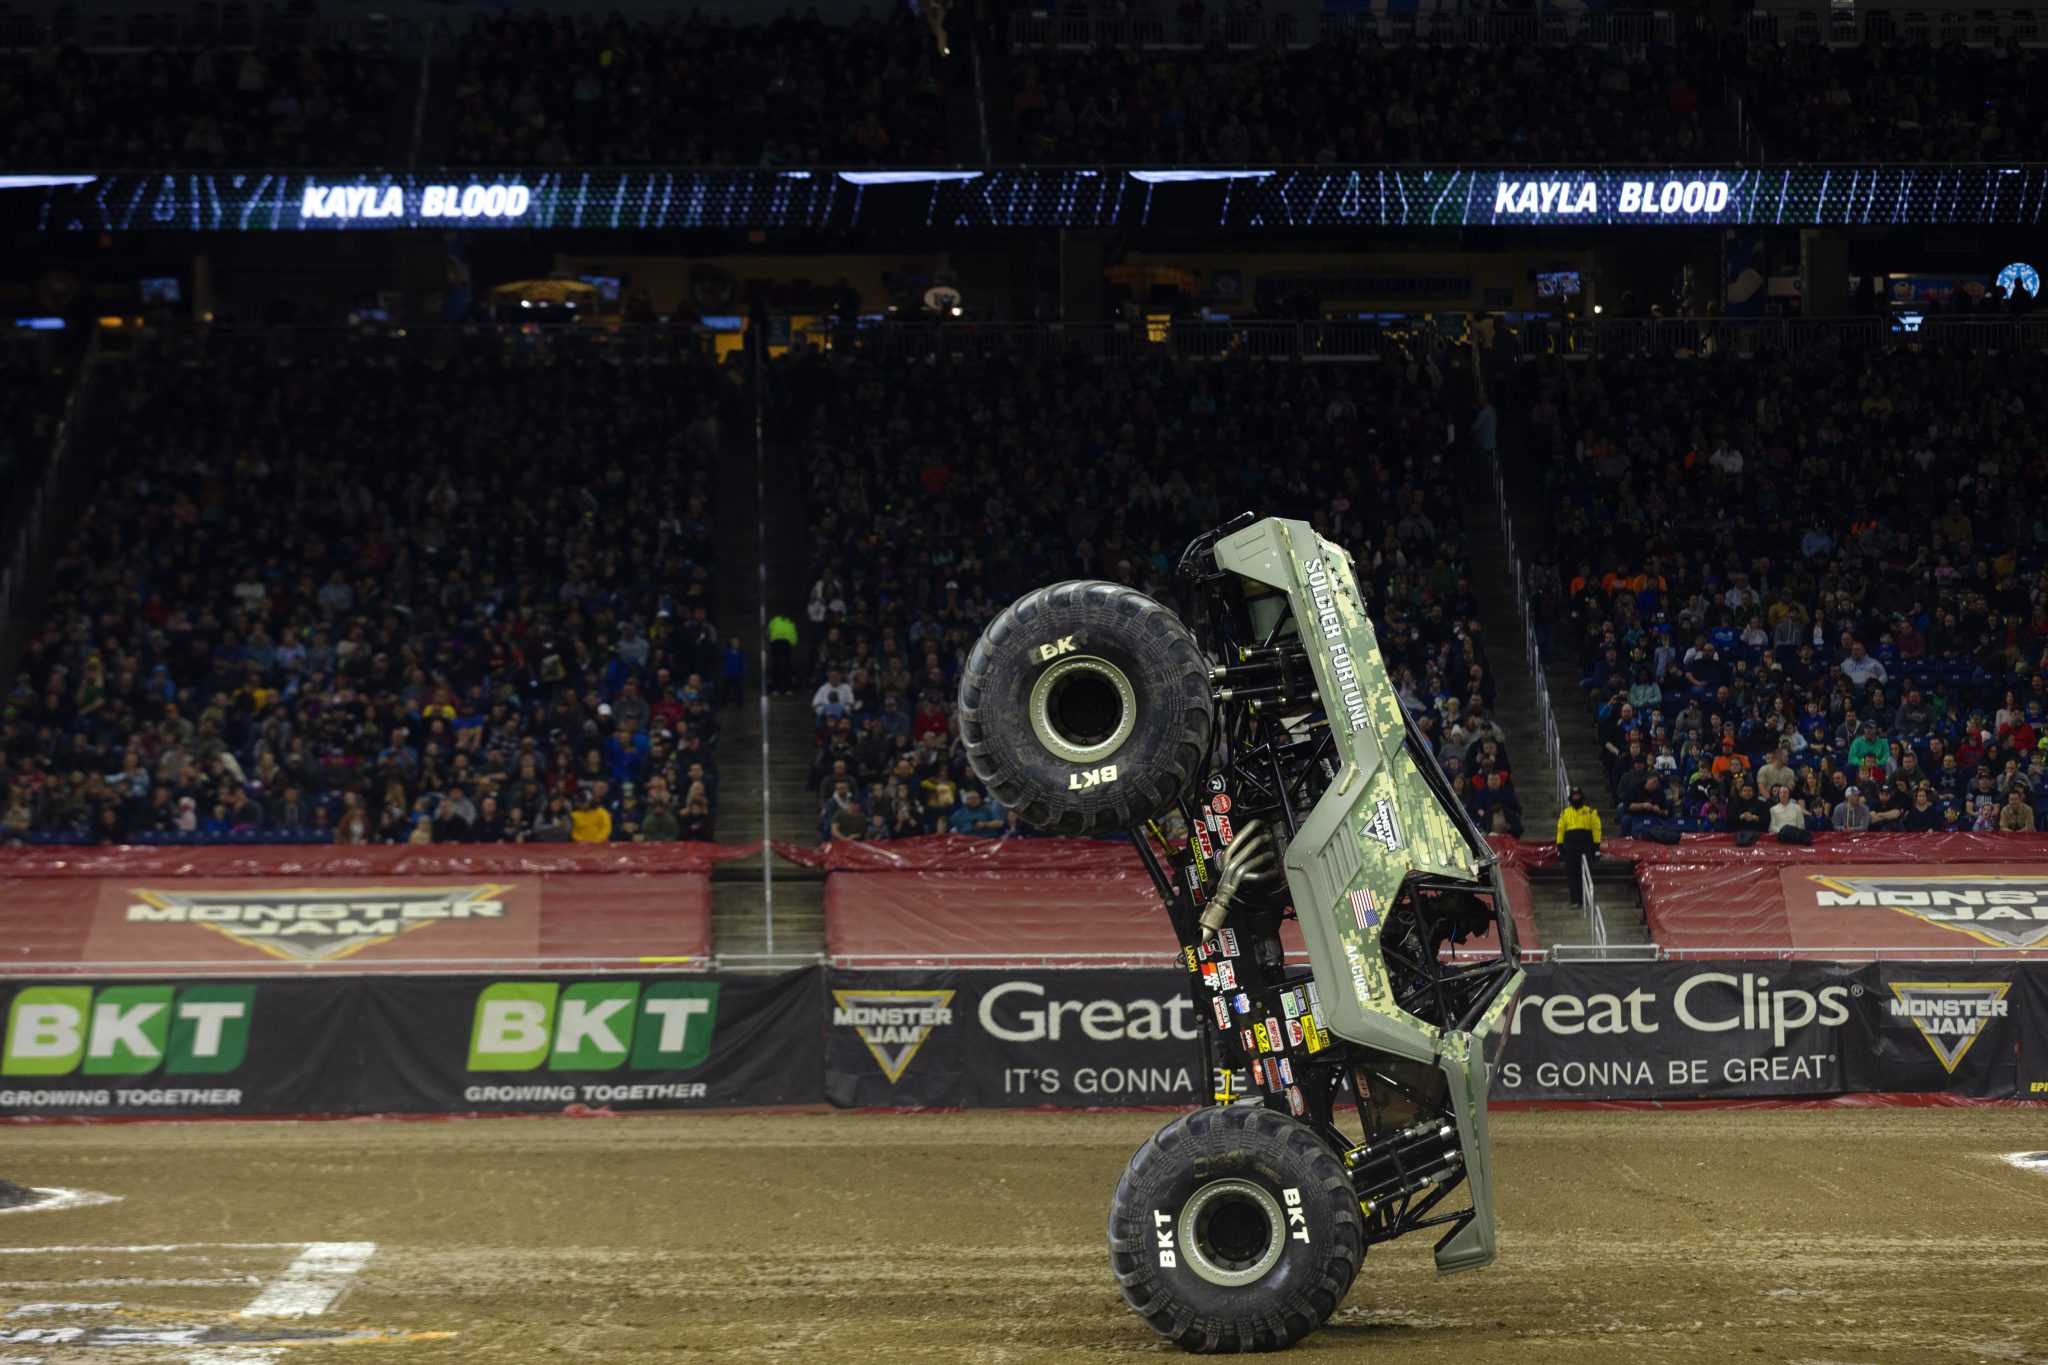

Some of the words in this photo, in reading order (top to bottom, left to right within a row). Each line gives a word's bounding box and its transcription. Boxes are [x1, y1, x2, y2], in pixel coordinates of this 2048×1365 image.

[301, 185, 403, 218] KAYLA
[420, 185, 530, 217] BLOOD
[1494, 182, 1597, 213] KAYLA
[1618, 181, 1729, 213] BLOOD
[1304, 558, 1342, 640] SOLDIER
[1328, 642, 1371, 733] FORTUNE
[1067, 765, 1118, 790] BKT
[1196, 820, 1212, 857] ARP
[1373, 817, 1387, 840] JAM
[1376, 800, 1397, 851] MONSTER
[126, 900, 504, 922] MONSTER
[1816, 890, 2048, 906] MONST
[232, 918, 398, 935] JAM
[1184, 945, 1199, 972] UNOH
[833, 1007, 953, 1025] MONSTER
[978, 981, 1198, 1042] Great
[1490, 986, 1659, 1035] reat
[1891, 999, 2008, 1017] MONSTER
[10, 1002, 246, 1057] BKT
[476, 998, 710, 1053] BKT
[867, 1026, 919, 1043] JAM
[1267, 1020, 1281, 1048] SIMPSON
[1925, 1017, 1976, 1034] JAM
[1004, 1068, 1060, 1093] IT'S
[1074, 1067, 1193, 1093] GONNA
[1536, 1061, 1654, 1087] GONNA
[1668, 1060, 1709, 1084] BE
[0, 1089, 111, 1106] GROWING
[115, 1088, 243, 1106] TOGETHER
[464, 1086, 576, 1102] GROWING
[581, 1082, 707, 1100] TOGETHER
[1282, 1187, 1311, 1244] BKT
[1154, 1209, 1177, 1268] BKT
